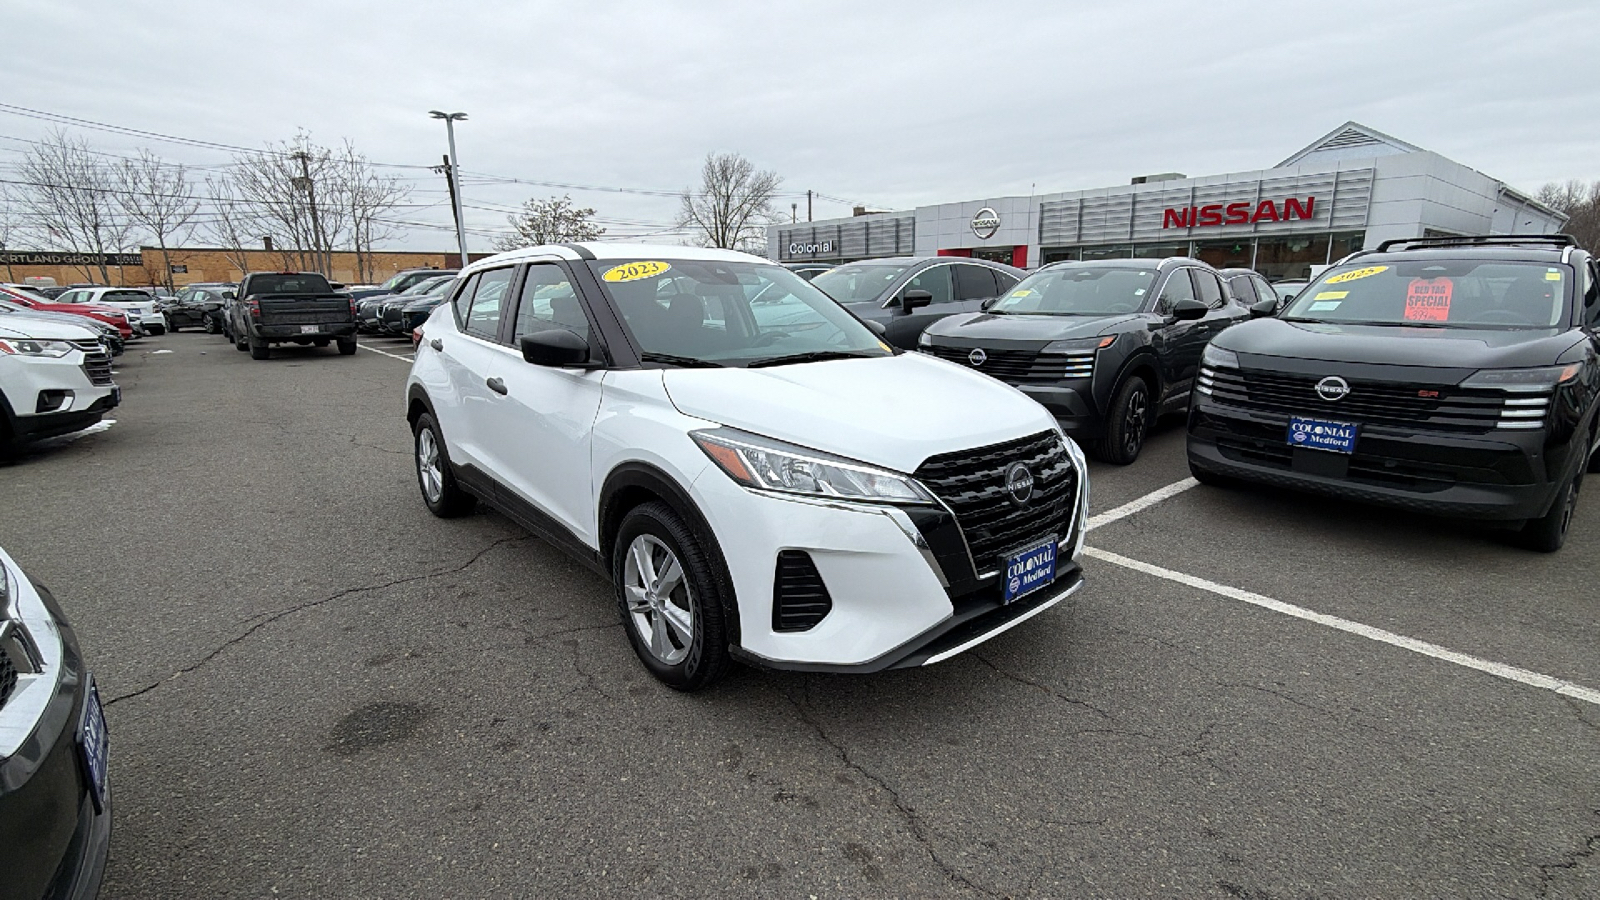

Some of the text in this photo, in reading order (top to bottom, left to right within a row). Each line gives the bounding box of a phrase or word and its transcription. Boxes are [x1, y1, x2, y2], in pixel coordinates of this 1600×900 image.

[1163, 196, 1316, 229] NISSAN
[789, 239, 833, 254] Colonial
[616, 262, 660, 280] 2023
[1336, 268, 1375, 282] 2025
[1431, 286, 1446, 294] TAG
[1408, 295, 1449, 307] SPECIAL
[1314, 384, 1350, 394] NISSAN
[1291, 422, 1354, 439] COLONIAL
[1310, 434, 1349, 447] Medford
[1007, 477, 1034, 491] NISSAN
[1007, 548, 1054, 579] COLONIAL
[1022, 564, 1052, 586] Medford
